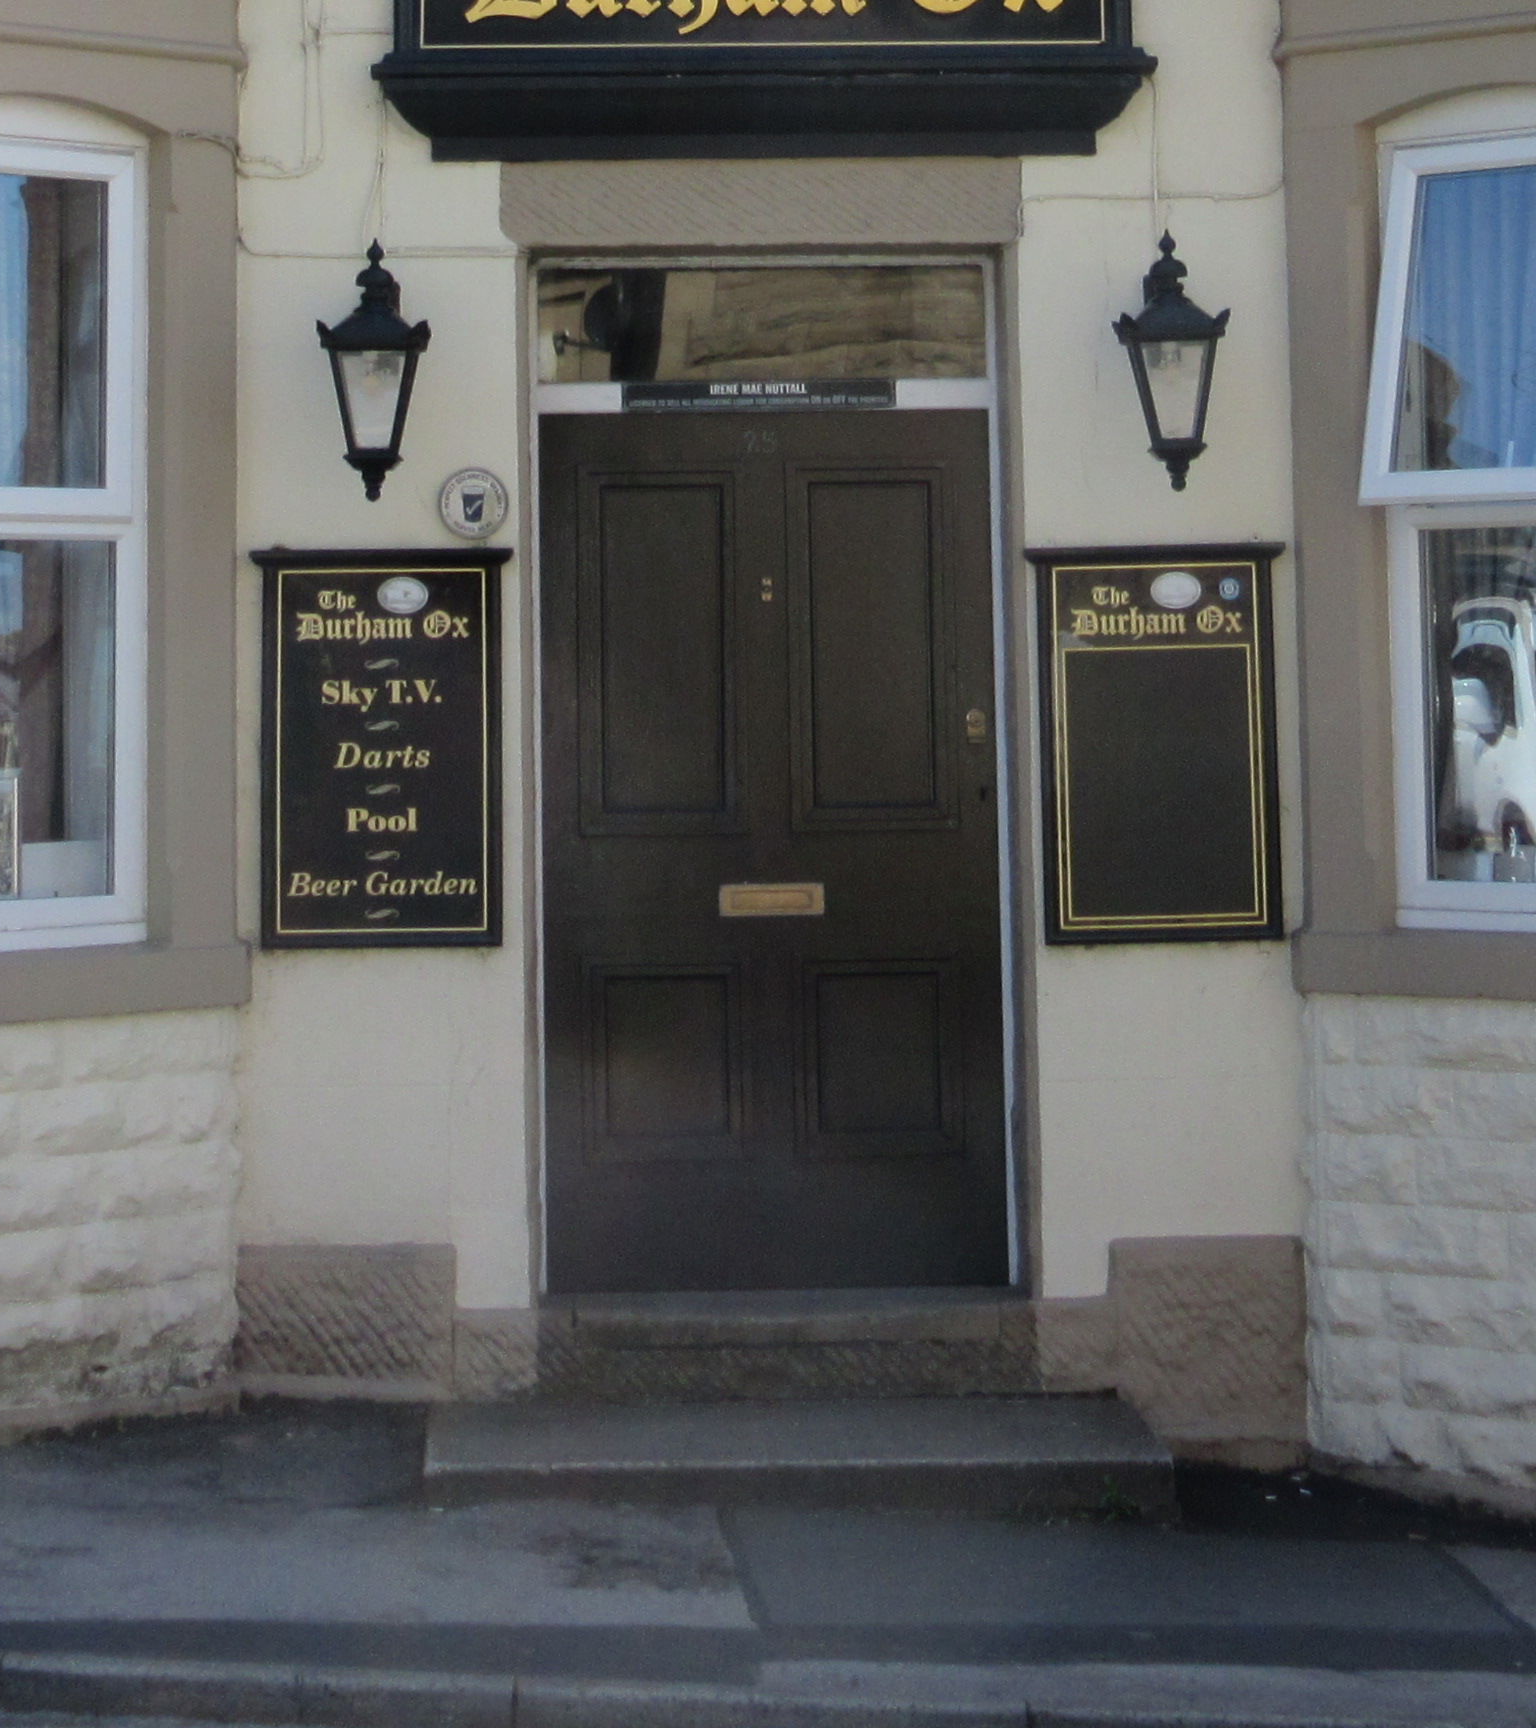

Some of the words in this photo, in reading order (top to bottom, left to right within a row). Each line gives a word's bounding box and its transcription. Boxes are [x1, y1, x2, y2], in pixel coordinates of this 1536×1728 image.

[709, 383, 738, 395] IRENE
[317, 590, 356, 613] The
[1091, 584, 1130, 608] The
[296, 610, 413, 646] Durham
[422, 609, 470, 639] Ox
[1070, 605, 1186, 640] Durham
[1195, 604, 1242, 634] Ox
[321, 679, 378, 712] Sky
[385, 679, 442, 704] T.V.
[333, 741, 431, 769] Darts
[345, 807, 418, 832] Pool
[287, 872, 357, 897] Beer
[365, 870, 478, 896] Garden
